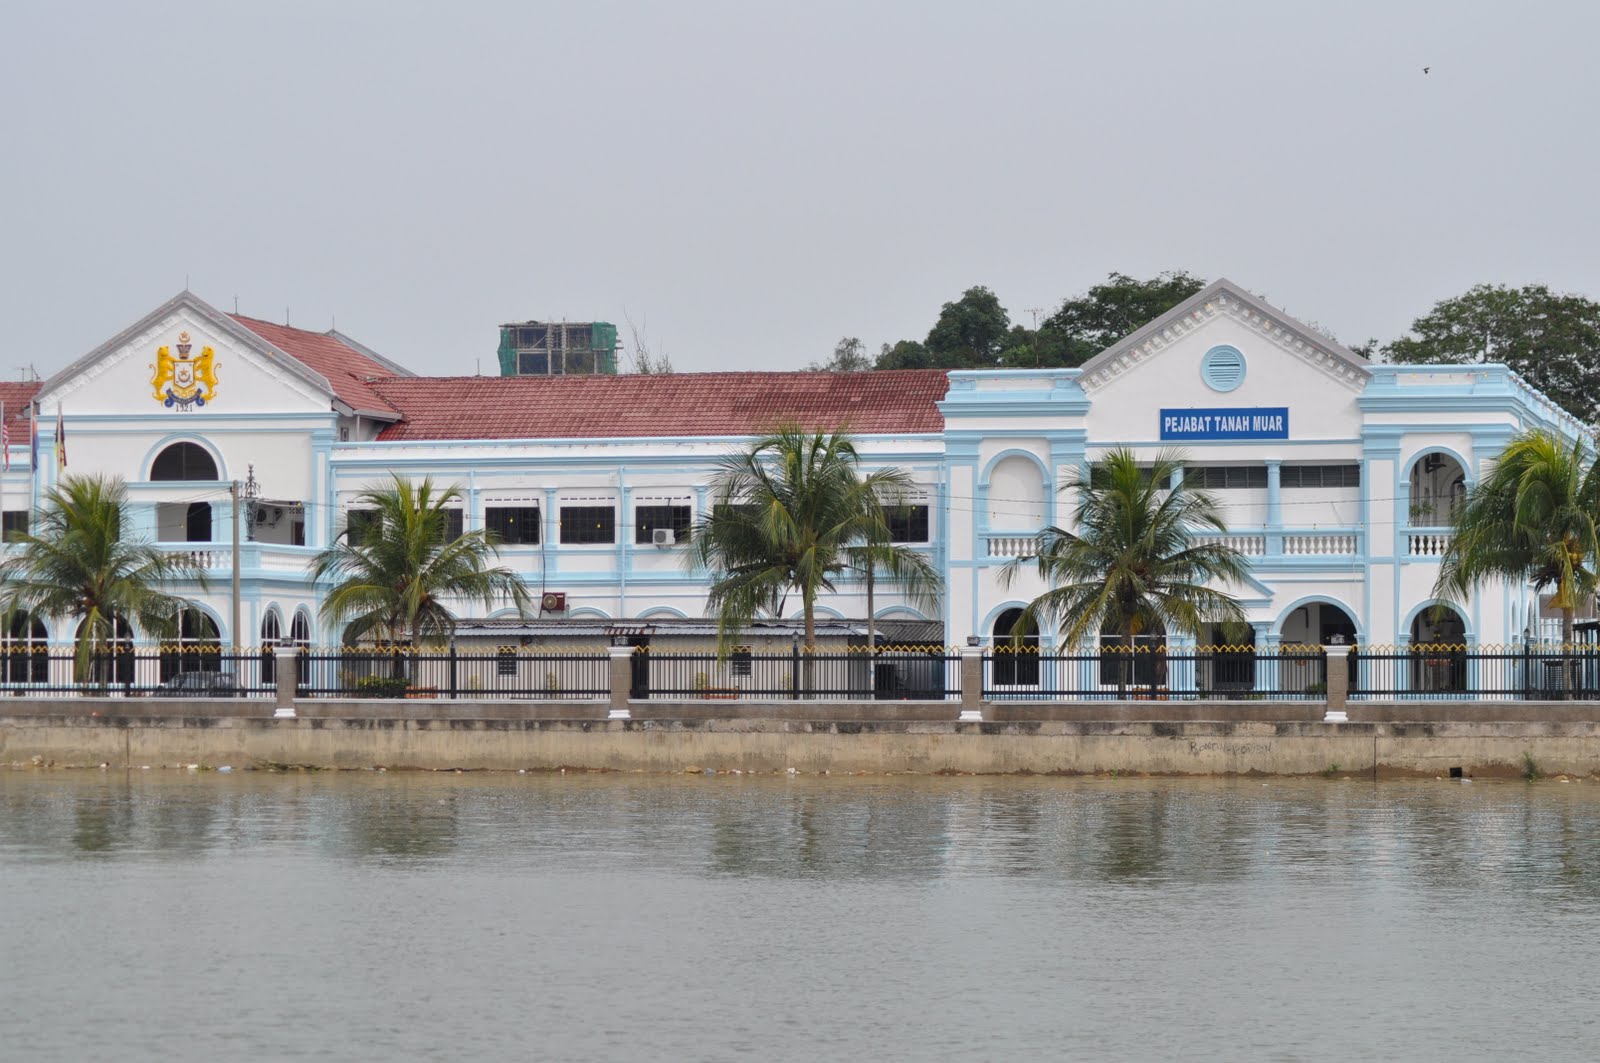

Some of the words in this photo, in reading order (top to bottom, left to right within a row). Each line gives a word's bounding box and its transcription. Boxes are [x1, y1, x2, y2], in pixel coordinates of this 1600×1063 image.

[1164, 416, 1211, 432] PEJABAT
[1214, 416, 1250, 432] TANAH
[1252, 415, 1283, 431] MUAR
